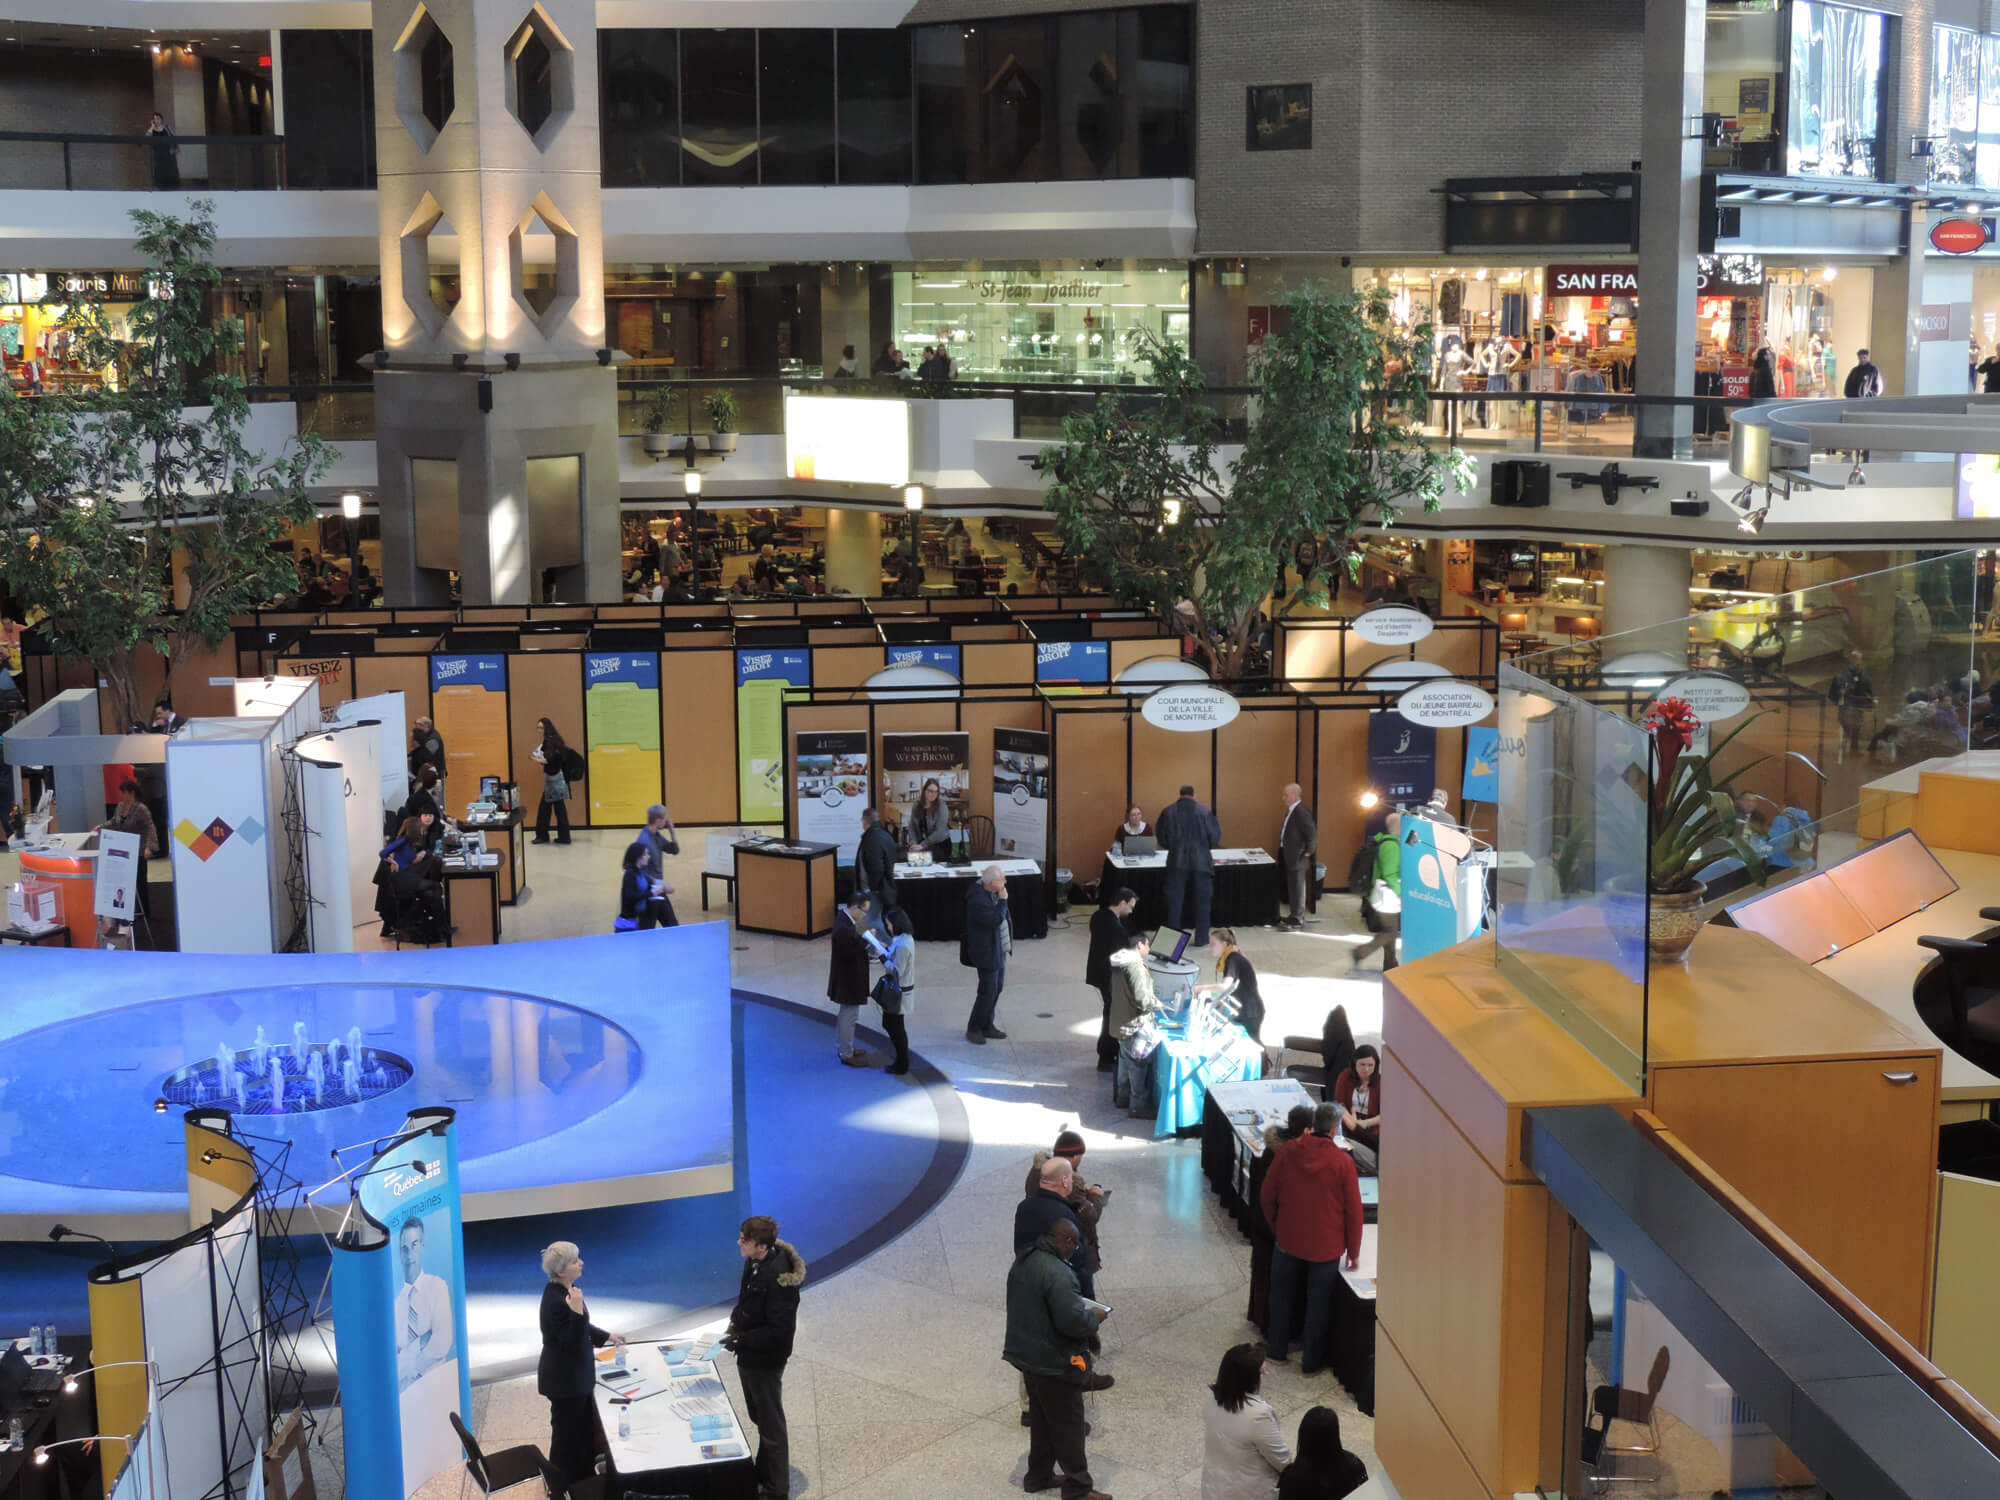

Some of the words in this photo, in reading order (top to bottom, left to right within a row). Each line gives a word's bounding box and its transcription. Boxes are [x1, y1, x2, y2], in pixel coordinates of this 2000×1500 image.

[1556, 273, 1596, 290] SAN
[980, 279, 1032, 304] St-Jean
[1040, 278, 1104, 304] Joaillier
[268, 632, 278, 644] F
[1037, 645, 1070, 665] DROIT
[287, 659, 342, 677] VISEZ
[437, 664, 466, 680] DROIT
[590, 662, 620, 678] DROIT
[742, 660, 772, 675] DROIT
[1157, 697, 1180, 705] COUR
[1422, 693, 1473, 701] ASSOCIATION
[1168, 705, 1179, 713] DE
[1180, 705, 1191, 713] LA
[1192, 705, 1214, 713] VILLE
[1411, 702, 1422, 710] DU
[1447, 701, 1483, 709] BARREAU
[1163, 713, 1174, 721] DE
[1419, 710, 1430, 718] DE
[896, 752, 921, 761] WEST
[922, 752, 956, 761] BROME
[393, 1173, 425, 1197] Québec
[401, 1193, 442, 1217] humaines
